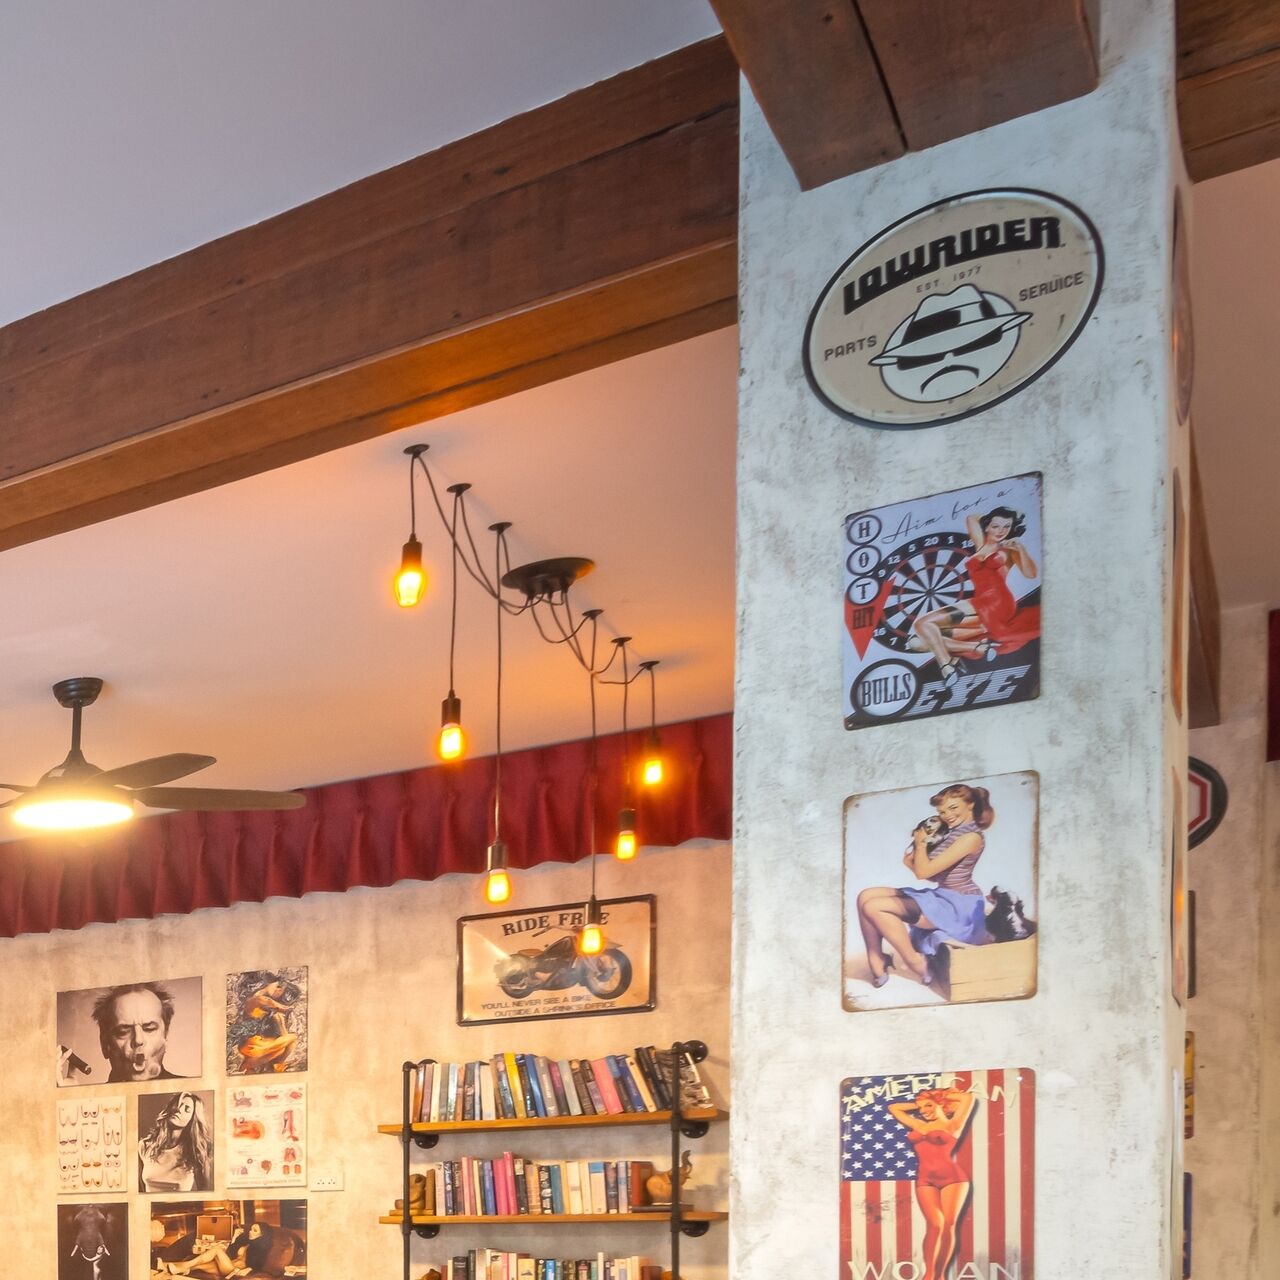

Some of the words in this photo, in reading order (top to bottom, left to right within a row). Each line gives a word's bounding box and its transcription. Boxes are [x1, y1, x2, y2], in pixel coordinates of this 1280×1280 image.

[843, 216, 1061, 316] LOWRIDER
[953, 264, 983, 282] 1977
[824, 335, 878, 361] PARTS
[881, 512, 943, 544] Aim
[951, 497, 989, 520] for
[997, 488, 1013, 498] a
[924, 537, 939, 547] 20
[852, 606, 874, 630] HIT
[861, 673, 912, 708] BULLS
[905, 664, 1032, 716] EYE
[502, 915, 550, 936] RIDE
[559, 912, 609, 926] FRE
[495, 1009, 531, 1017] OUTSIDE
[583, 1001, 616, 1010] OFFICE
[512, 999, 541, 1007] NEVER
[543, 997, 560, 1005] SEE
[571, 994, 592, 1002] BIKE
